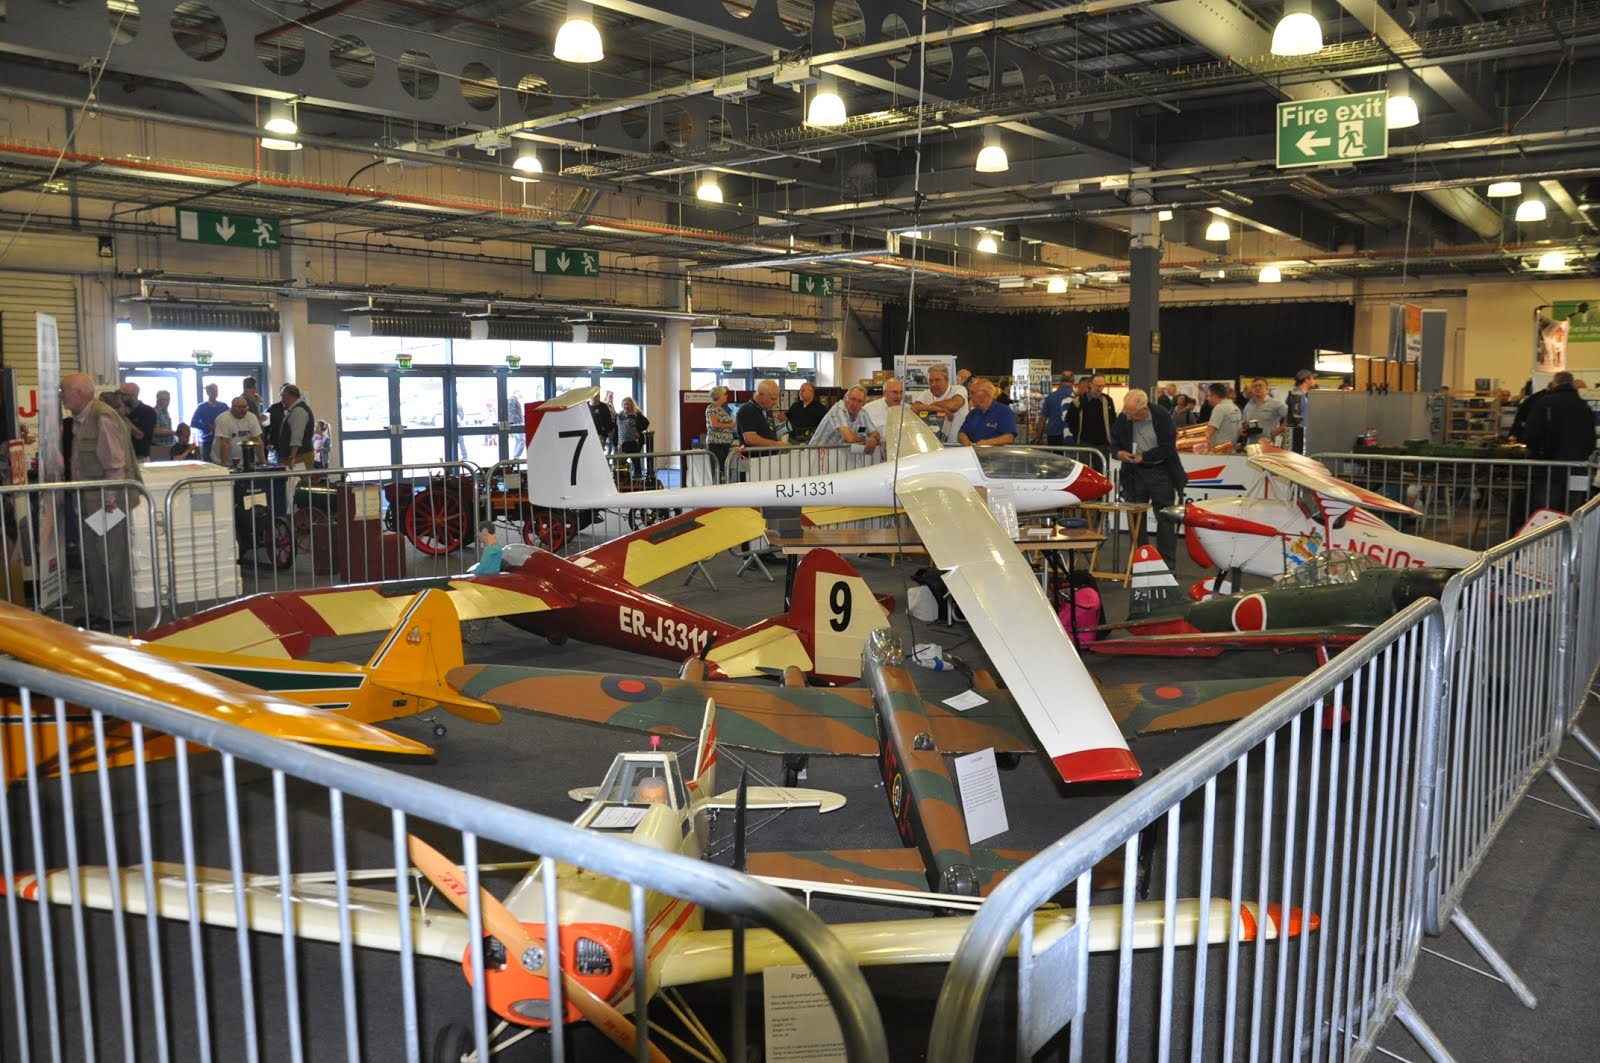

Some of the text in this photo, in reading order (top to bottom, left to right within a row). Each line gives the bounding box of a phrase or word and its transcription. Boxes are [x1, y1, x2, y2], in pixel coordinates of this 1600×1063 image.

[1282, 98, 1382, 128] Fire exit
[559, 429, 588, 486] 7
[776, 481, 834, 498] RJ-1331
[829, 580, 852, 632] 9
[619, 605, 708, 653] ER-J3311
[791, 972, 807, 980] Piper
